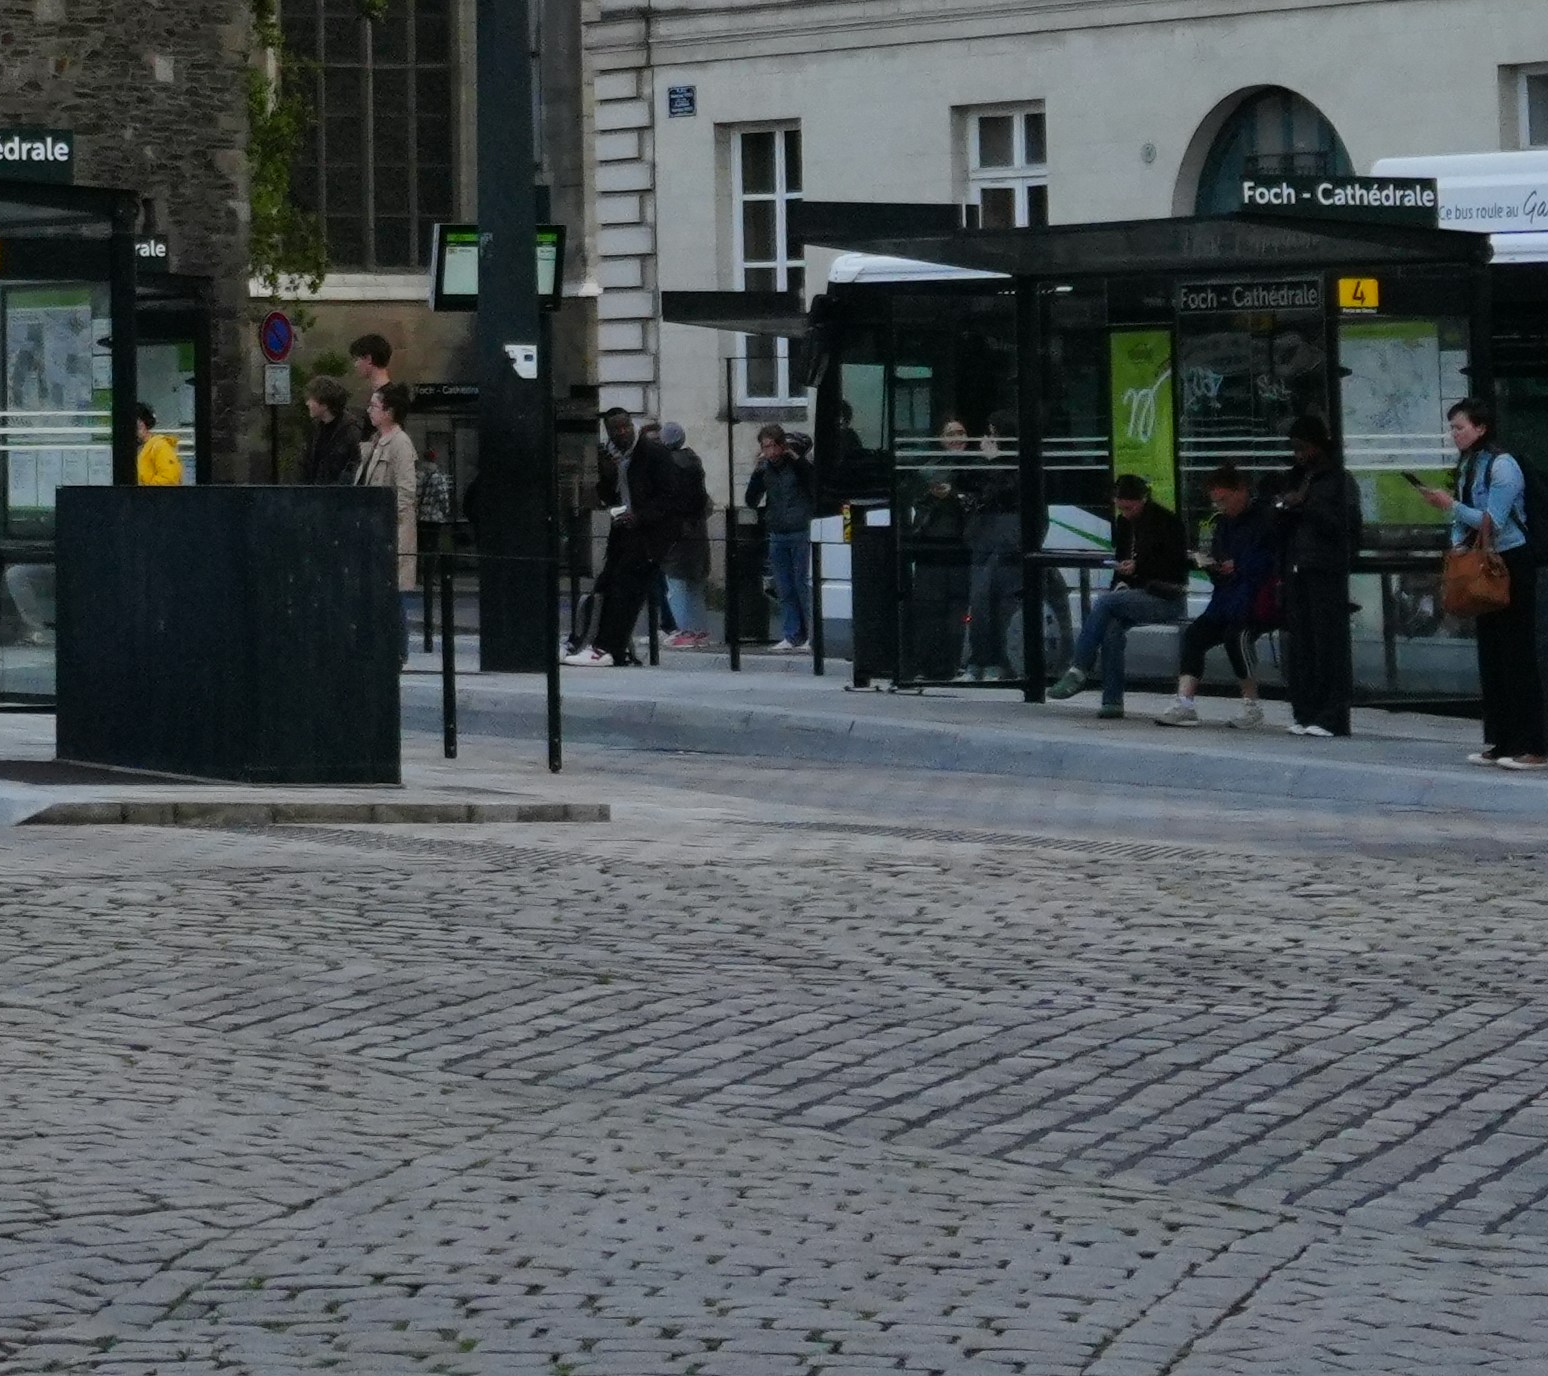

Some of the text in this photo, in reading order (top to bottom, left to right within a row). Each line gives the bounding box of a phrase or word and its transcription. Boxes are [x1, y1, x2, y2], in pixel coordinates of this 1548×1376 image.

[1242, 181, 1296, 205] Foch
[1317, 182, 1436, 207] Cathédrale
[1439, 205, 1452, 220] Ce
[1454, 203, 1474, 220] bus
[1476, 202, 1504, 219] roule
[1506, 206, 1519, 218] au
[1180, 287, 1217, 309] Foch
[1232, 285, 1318, 308] Cathédrale
[1352, 280, 1366, 305] 4
